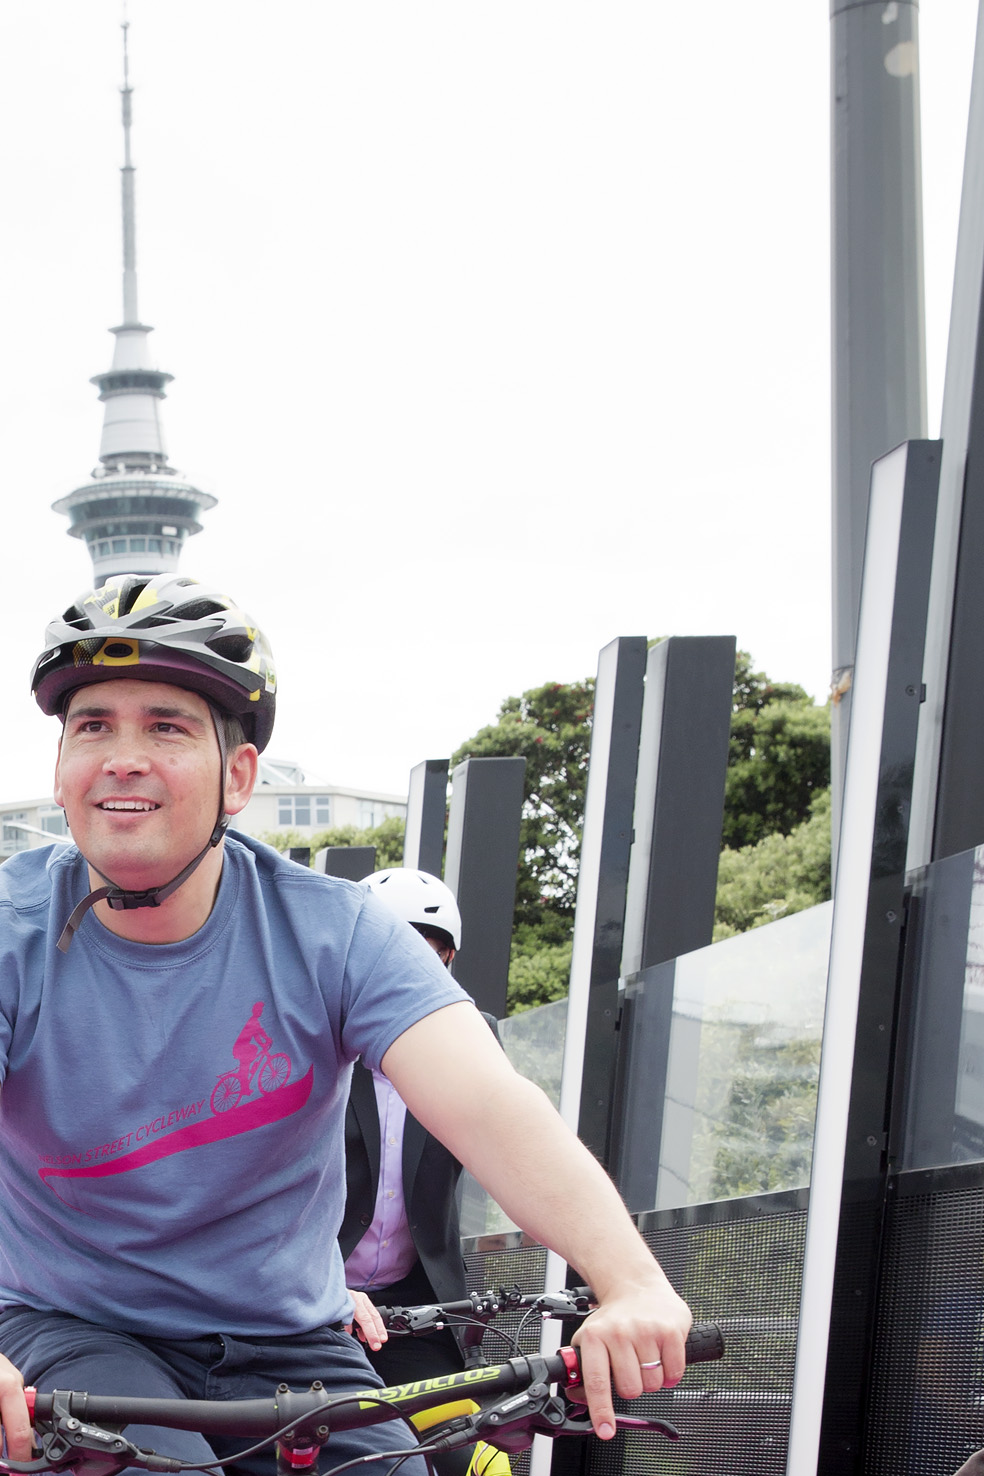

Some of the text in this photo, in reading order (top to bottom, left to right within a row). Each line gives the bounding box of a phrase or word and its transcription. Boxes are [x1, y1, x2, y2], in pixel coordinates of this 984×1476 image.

[38, 1099, 206, 1165] NELSON STREET CYCLEWAY
